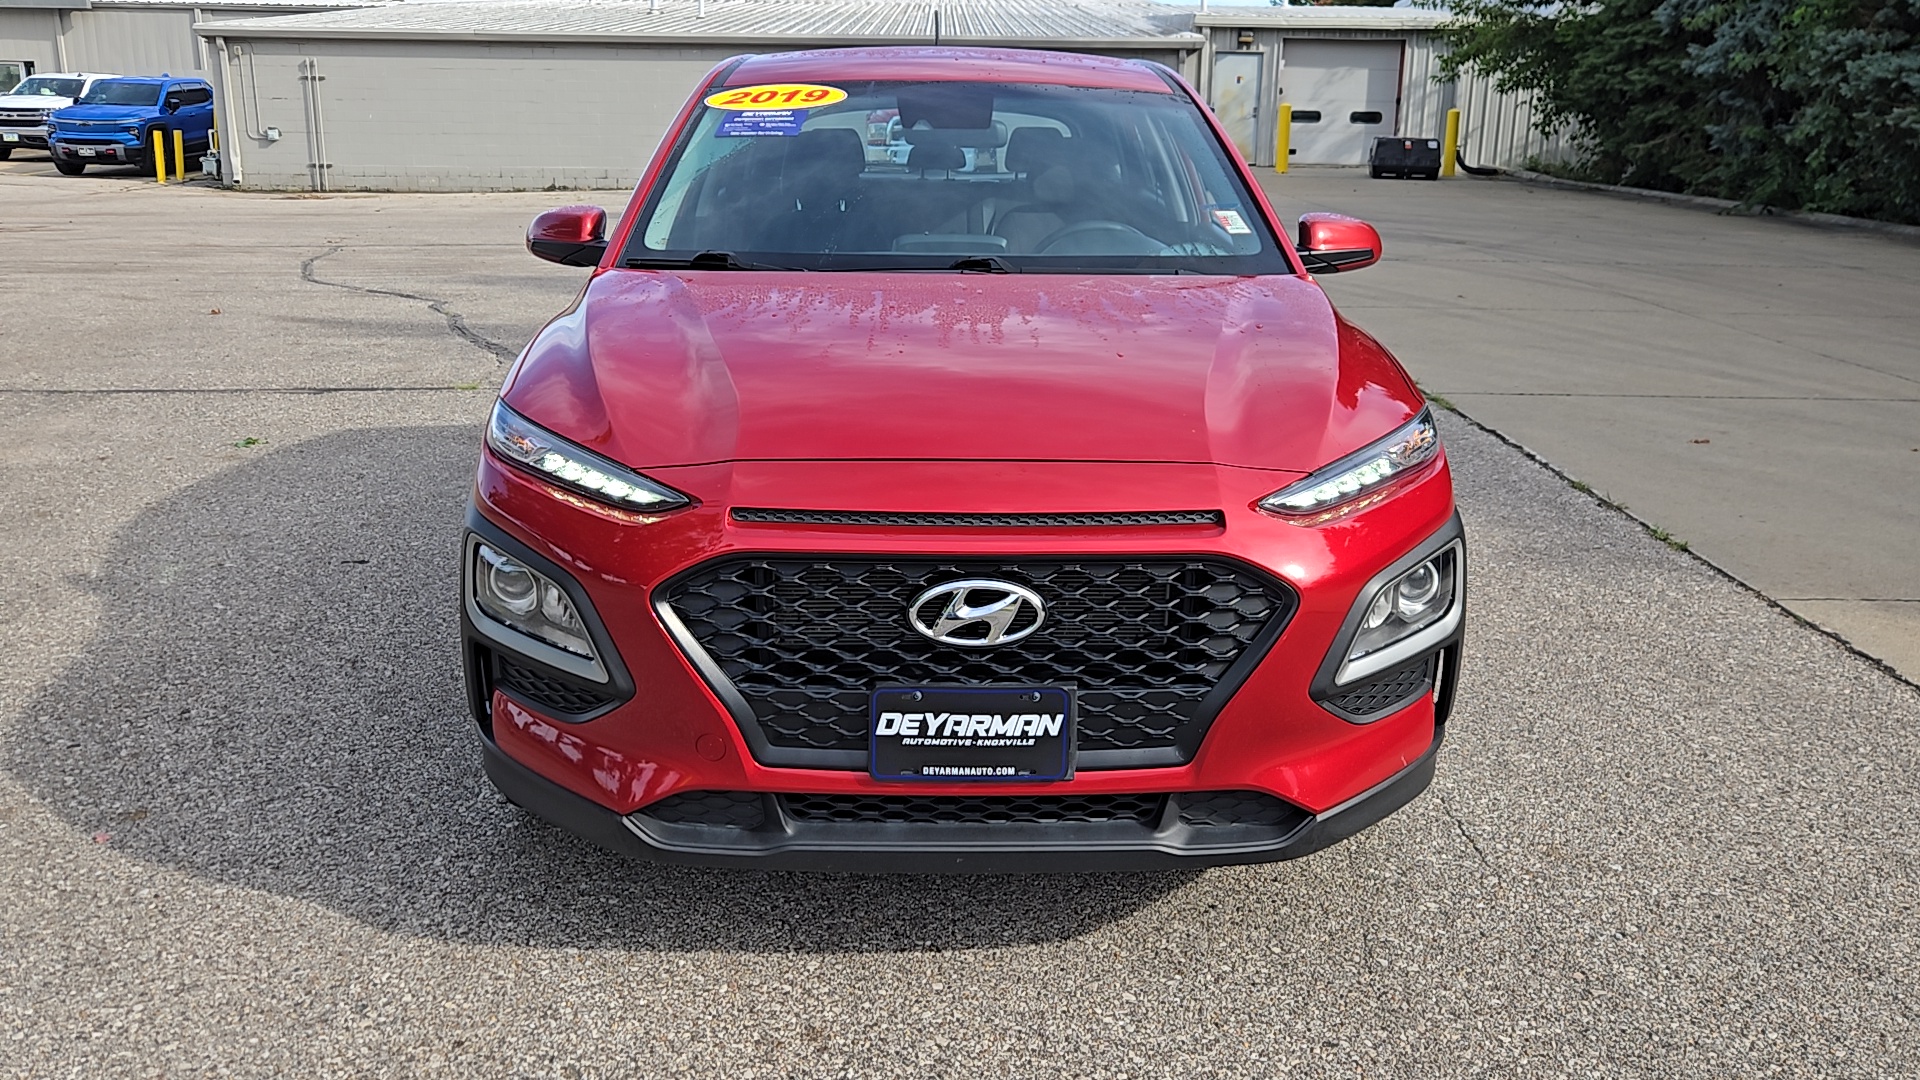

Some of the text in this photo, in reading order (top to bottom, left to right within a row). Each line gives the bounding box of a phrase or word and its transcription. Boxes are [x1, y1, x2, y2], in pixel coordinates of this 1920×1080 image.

[719, 89, 830, 105] 2019
[875, 713, 1064, 736] DEYARMAN
[922, 766, 1015, 776] DEYARMANAUTO.COM
